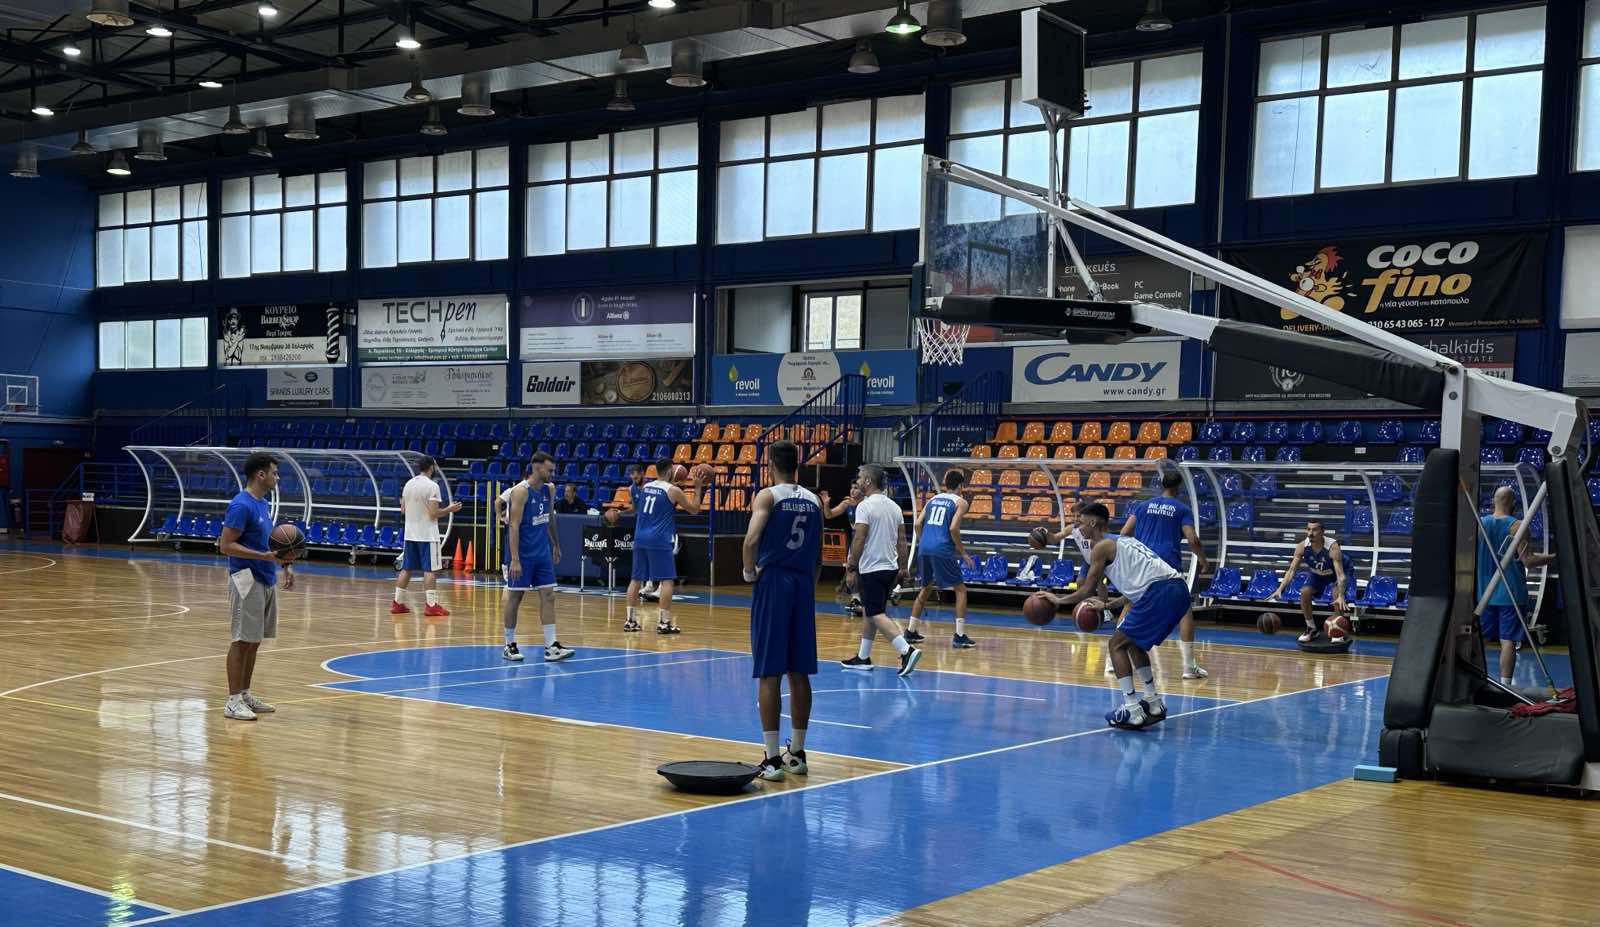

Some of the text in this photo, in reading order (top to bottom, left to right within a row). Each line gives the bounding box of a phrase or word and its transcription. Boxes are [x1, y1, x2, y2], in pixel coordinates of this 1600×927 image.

[1064, 261, 1116, 274] επκευές
[1134, 280, 1144, 288] PC
[1134, 291, 1182, 300] Game Console
[1361, 268, 1473, 313] fino
[1398, 300, 1420, 308] γεύση
[1430, 298, 1470, 306] κοτόπουλο
[1384, 320, 1394, 328] 65
[1395, 320, 1406, 328] 43
[1408, 319, 1423, 328] 065
[1430, 319, 1445, 327] 127
[526, 374, 576, 392] Goldair
[735, 378, 760, 390] revoil
[866, 376, 894, 388] revoil
[315, 387, 330, 395] CARS
[1103, 386, 1166, 397] www.candy.gr
[539, 503, 544, 514] 9
[644, 496, 656, 514] 11
[928, 506, 946, 526] 10
[786, 515, 807, 550] 5
